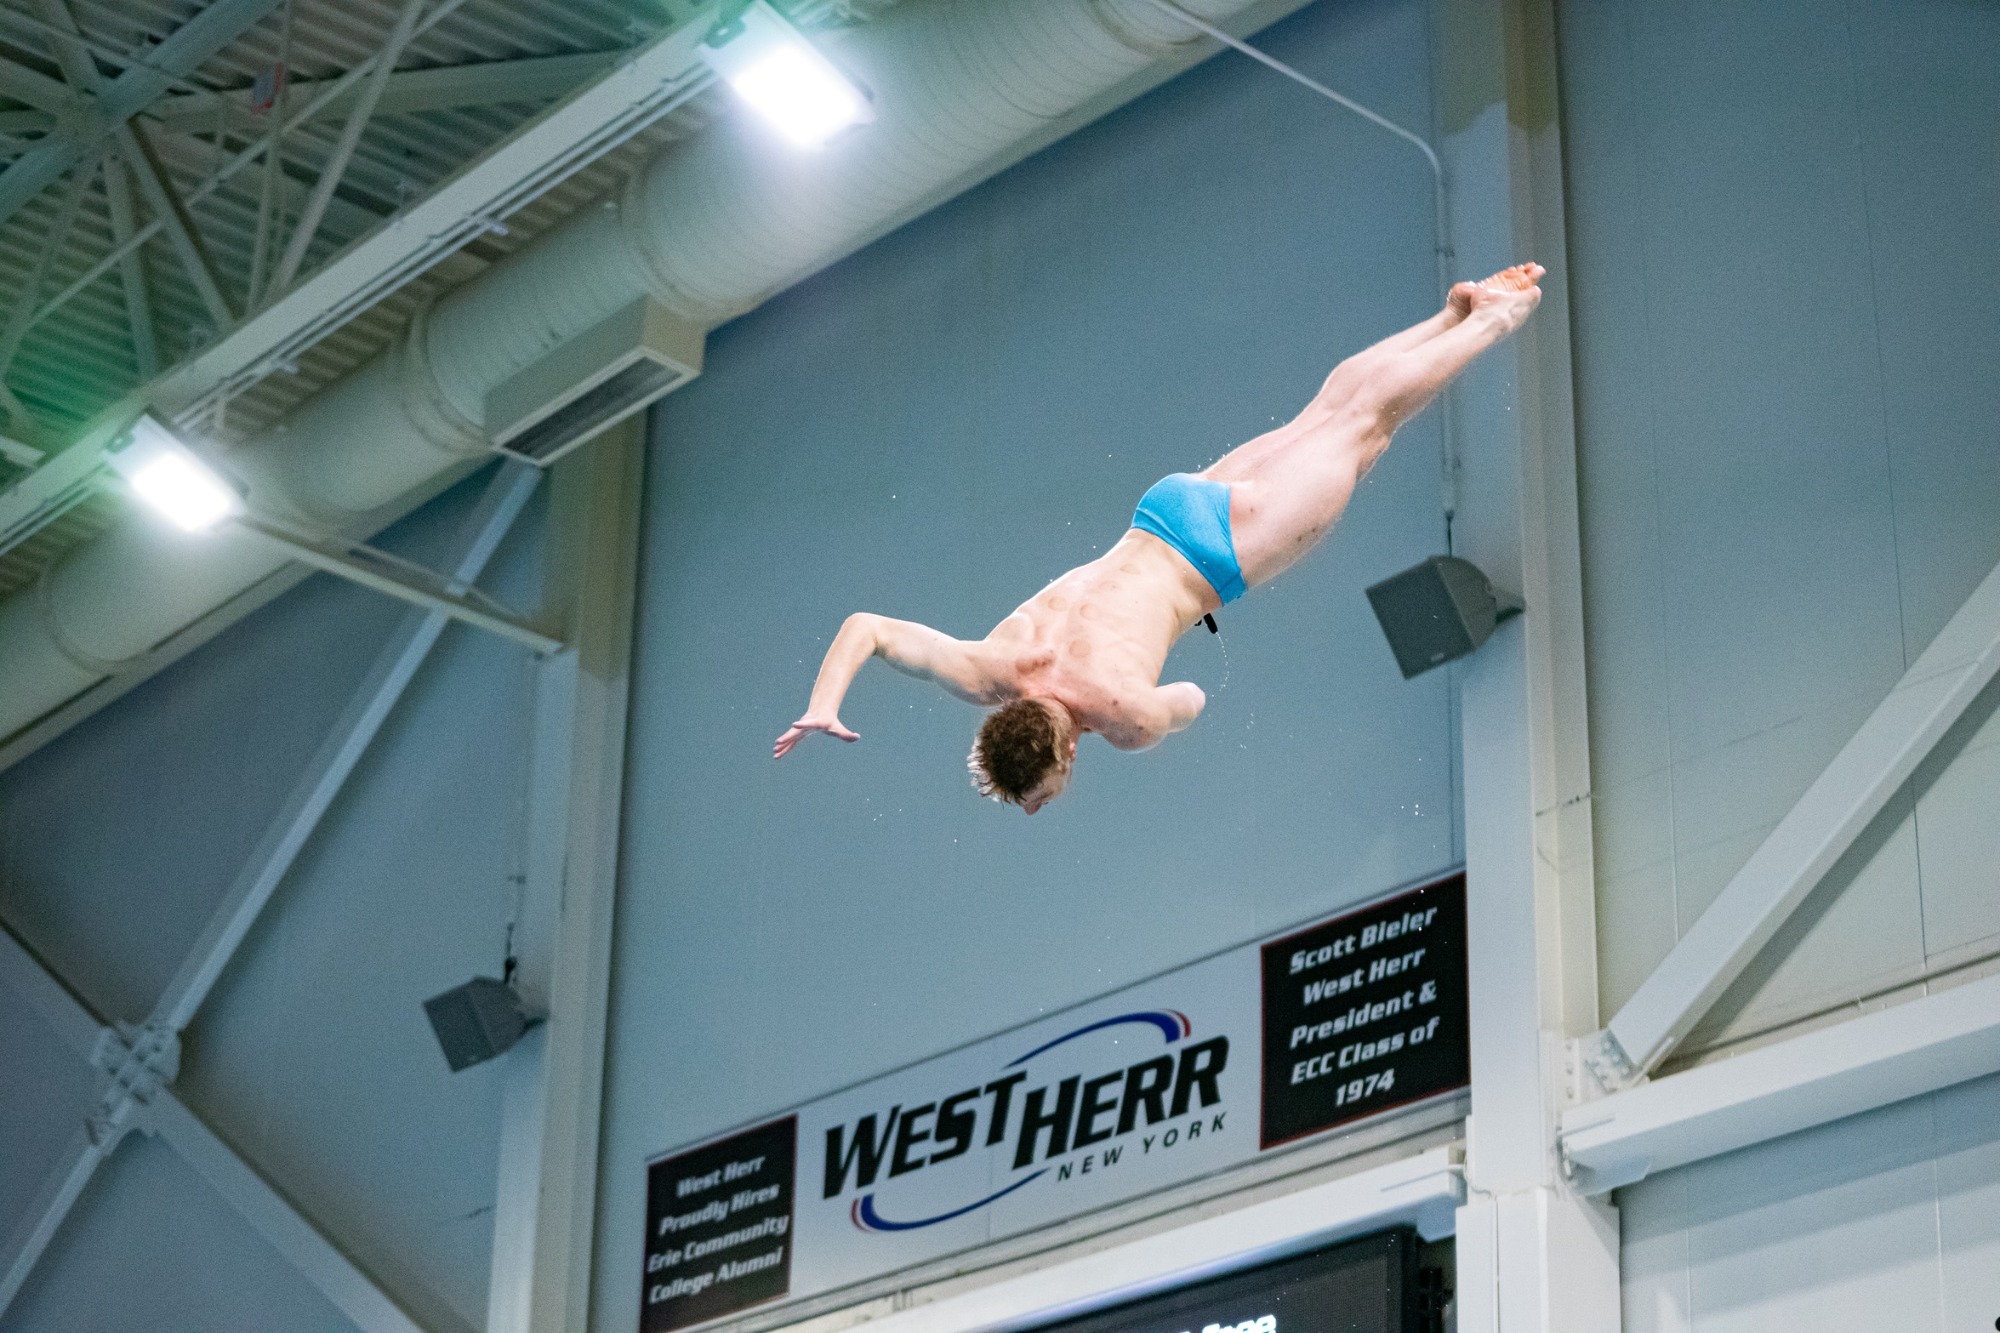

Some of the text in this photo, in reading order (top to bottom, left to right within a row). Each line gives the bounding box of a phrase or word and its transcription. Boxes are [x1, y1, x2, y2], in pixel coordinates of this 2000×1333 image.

[1289, 907, 1438, 975] Scott Bieler
[1303, 948, 1426, 1006] West Herr
[1290, 979, 1437, 1049] President &
[1291, 1016, 1440, 1085] ECC Class of
[1336, 1068, 1395, 1107] 1974
[1057, 1111, 1228, 1182] NEW YORK
[676, 1156, 766, 1198] West Herr
[659, 1184, 780, 1236] Proudly Hires
[647, 1215, 790, 1272] Erie Community
[650, 1246, 784, 1304] College Alumni
